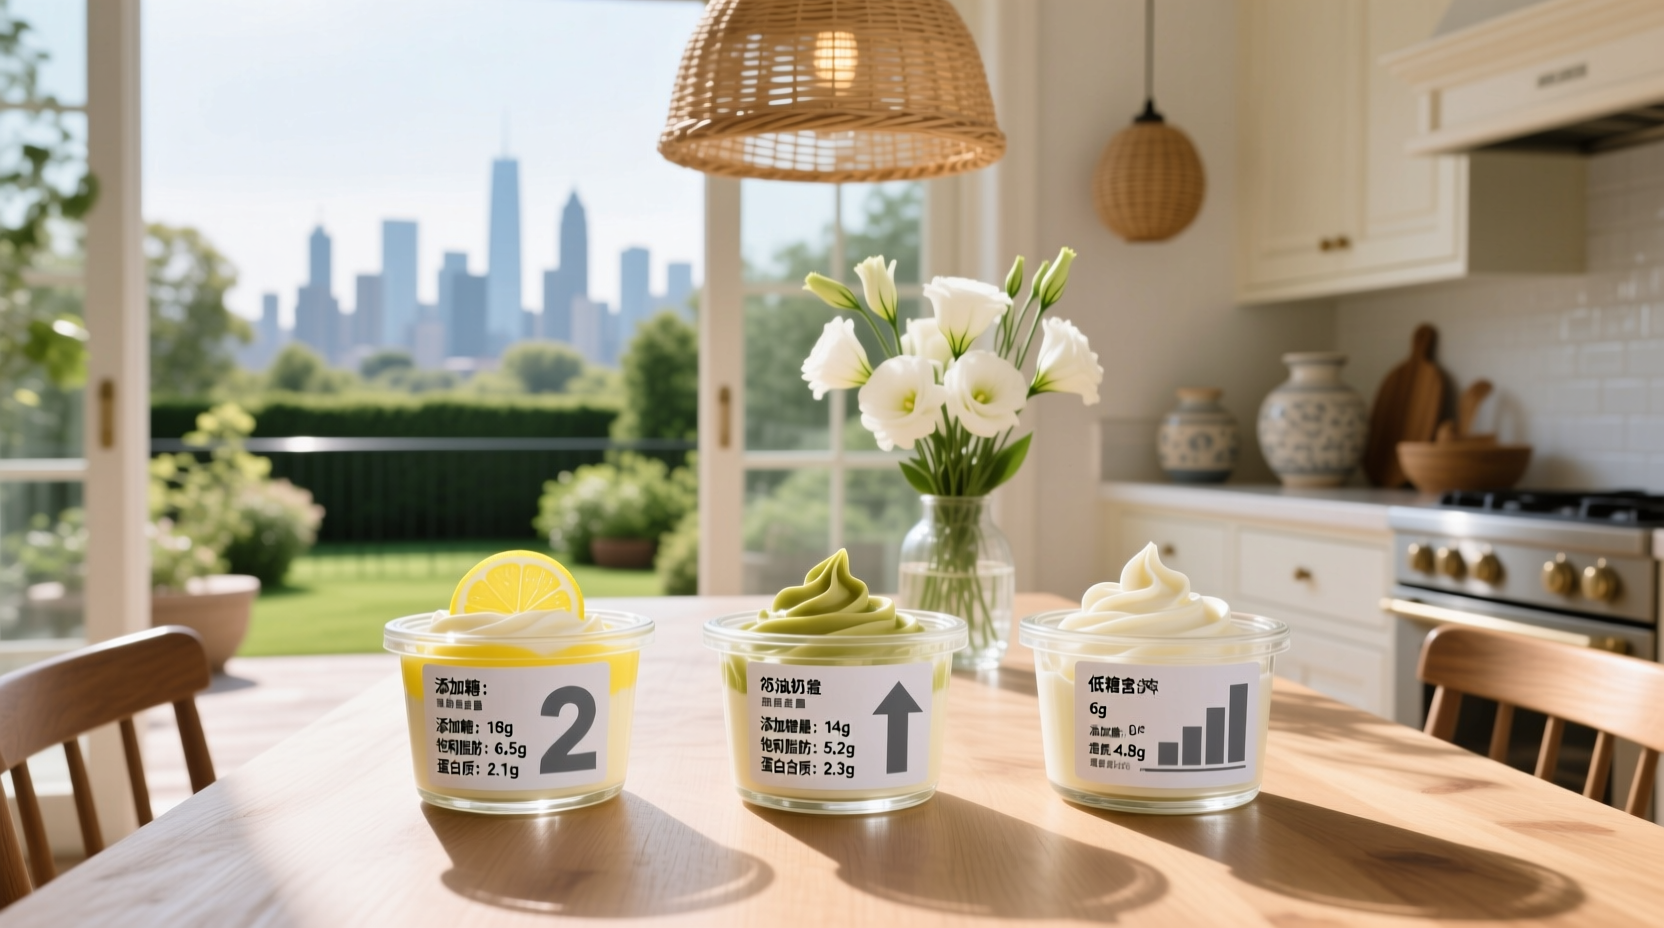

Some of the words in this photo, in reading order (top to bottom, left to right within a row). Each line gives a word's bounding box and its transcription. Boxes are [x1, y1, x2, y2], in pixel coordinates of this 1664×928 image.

[1089, 702, 1107, 719] 6g
[540, 685, 597, 775] 2
[825, 720, 851, 738] 14g
[494, 741, 528, 759] 6.5g
[823, 741, 856, 759] 5.2g
[1113, 744, 1147, 762] 4.8g
[487, 762, 520, 780] 2.1g
[823, 761, 856, 779] 2.3g
